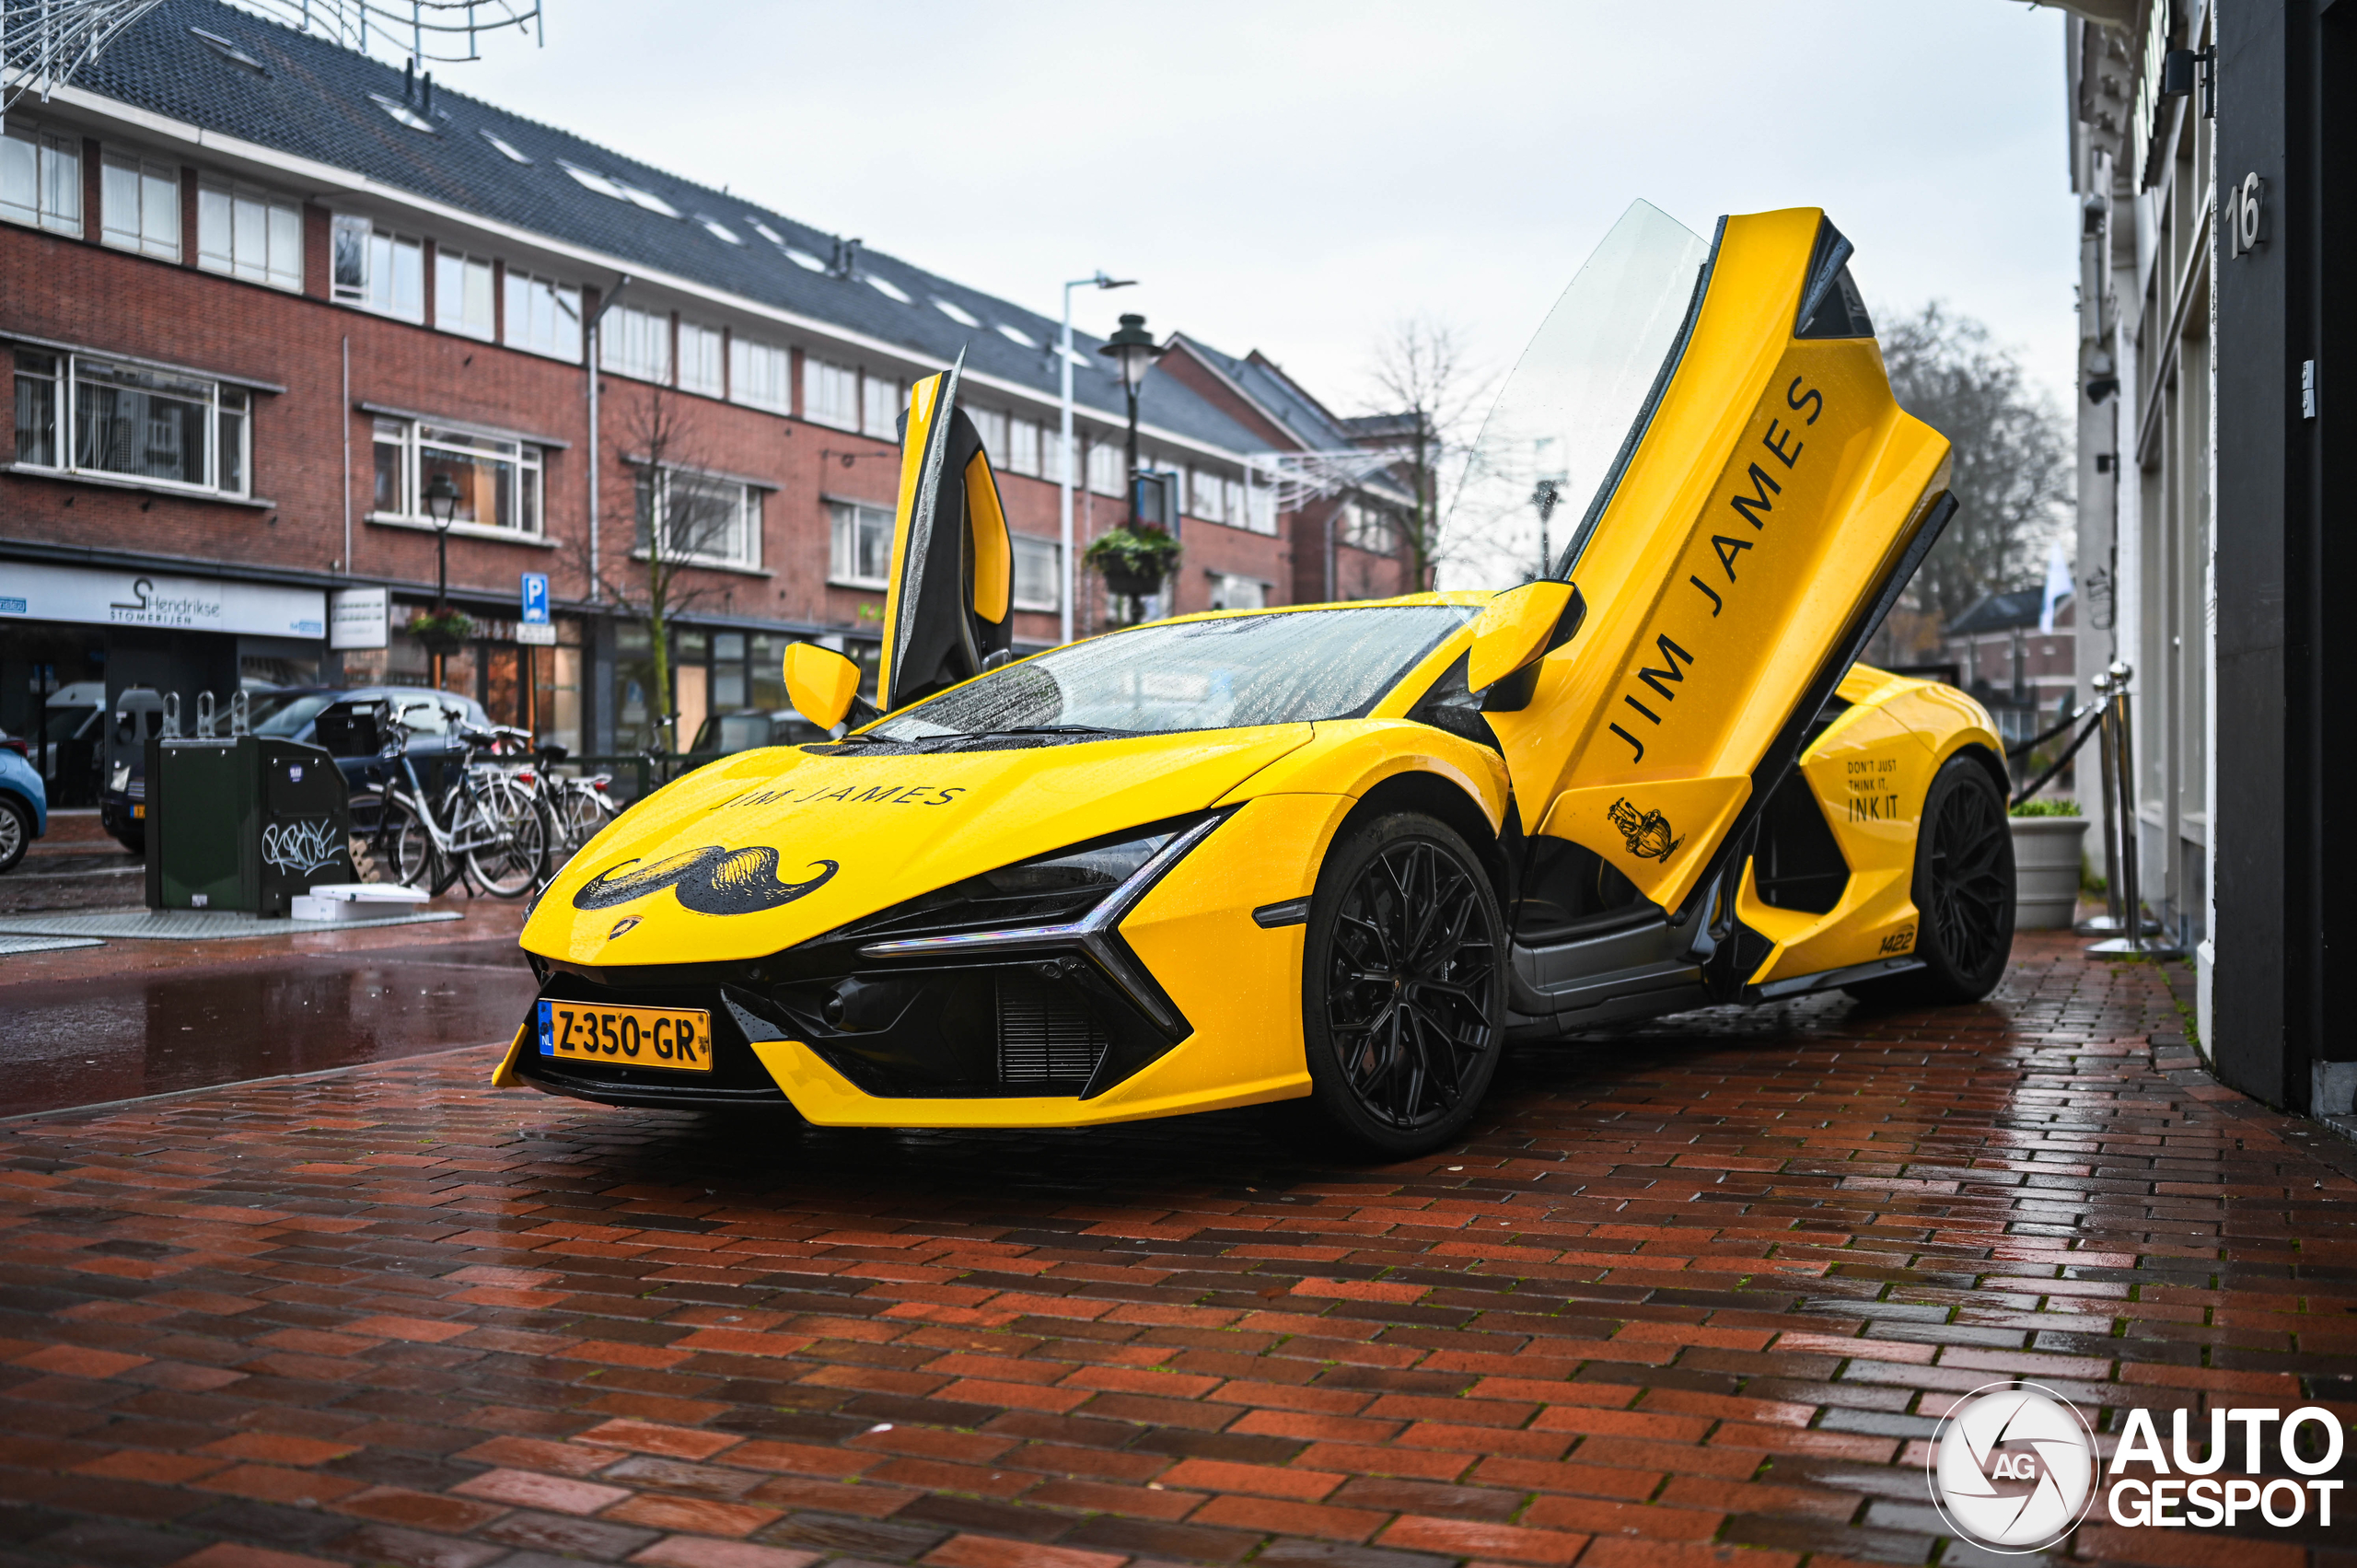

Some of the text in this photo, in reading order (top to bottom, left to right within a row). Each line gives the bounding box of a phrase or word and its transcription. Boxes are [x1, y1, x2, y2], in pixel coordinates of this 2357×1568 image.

[2224, 171, 2259, 261] 16
[1608, 375, 1824, 765] JIM JAMES
[528, 578, 543, 606] P
[110, 610, 192, 625] STOMERIJEN
[147, 595, 220, 618] Hendrikse
[1848, 759, 1897, 773] DON'T JUST
[1849, 777, 1888, 792] THINK IT,
[708, 785, 967, 810] JIM JAMES
[1849, 795, 1898, 823] INK IT
[1878, 932, 1914, 956] 1422
[541, 1034, 552, 1046] NL
[559, 1010, 698, 1062] Z-350-GR
